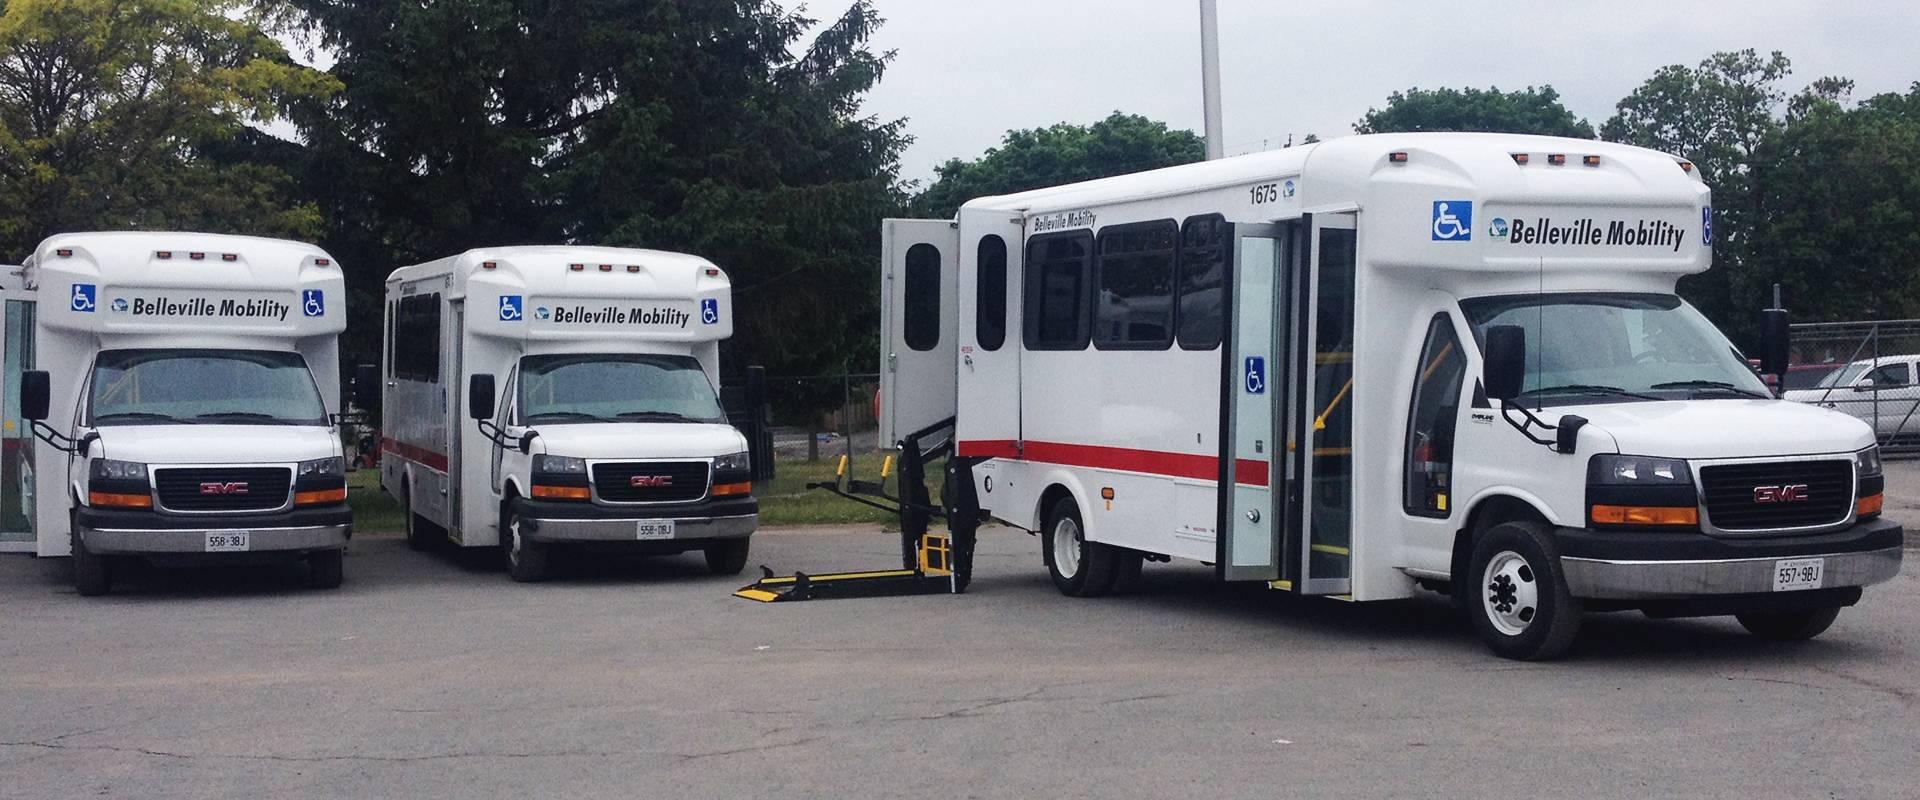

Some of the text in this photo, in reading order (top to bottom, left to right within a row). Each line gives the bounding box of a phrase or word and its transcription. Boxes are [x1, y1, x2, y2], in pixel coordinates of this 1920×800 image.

[1250, 184, 1277, 205] 1675
[1034, 210, 1097, 231] Belleville Mobility
[1510, 218, 1685, 252] Belleville Mobility
[132, 297, 290, 322] Belleville Mobility
[554, 306, 690, 329] Belleville Mobility
[200, 482, 249, 495] GMC
[630, 475, 673, 488] GMC
[1753, 484, 1808, 504] GMC
